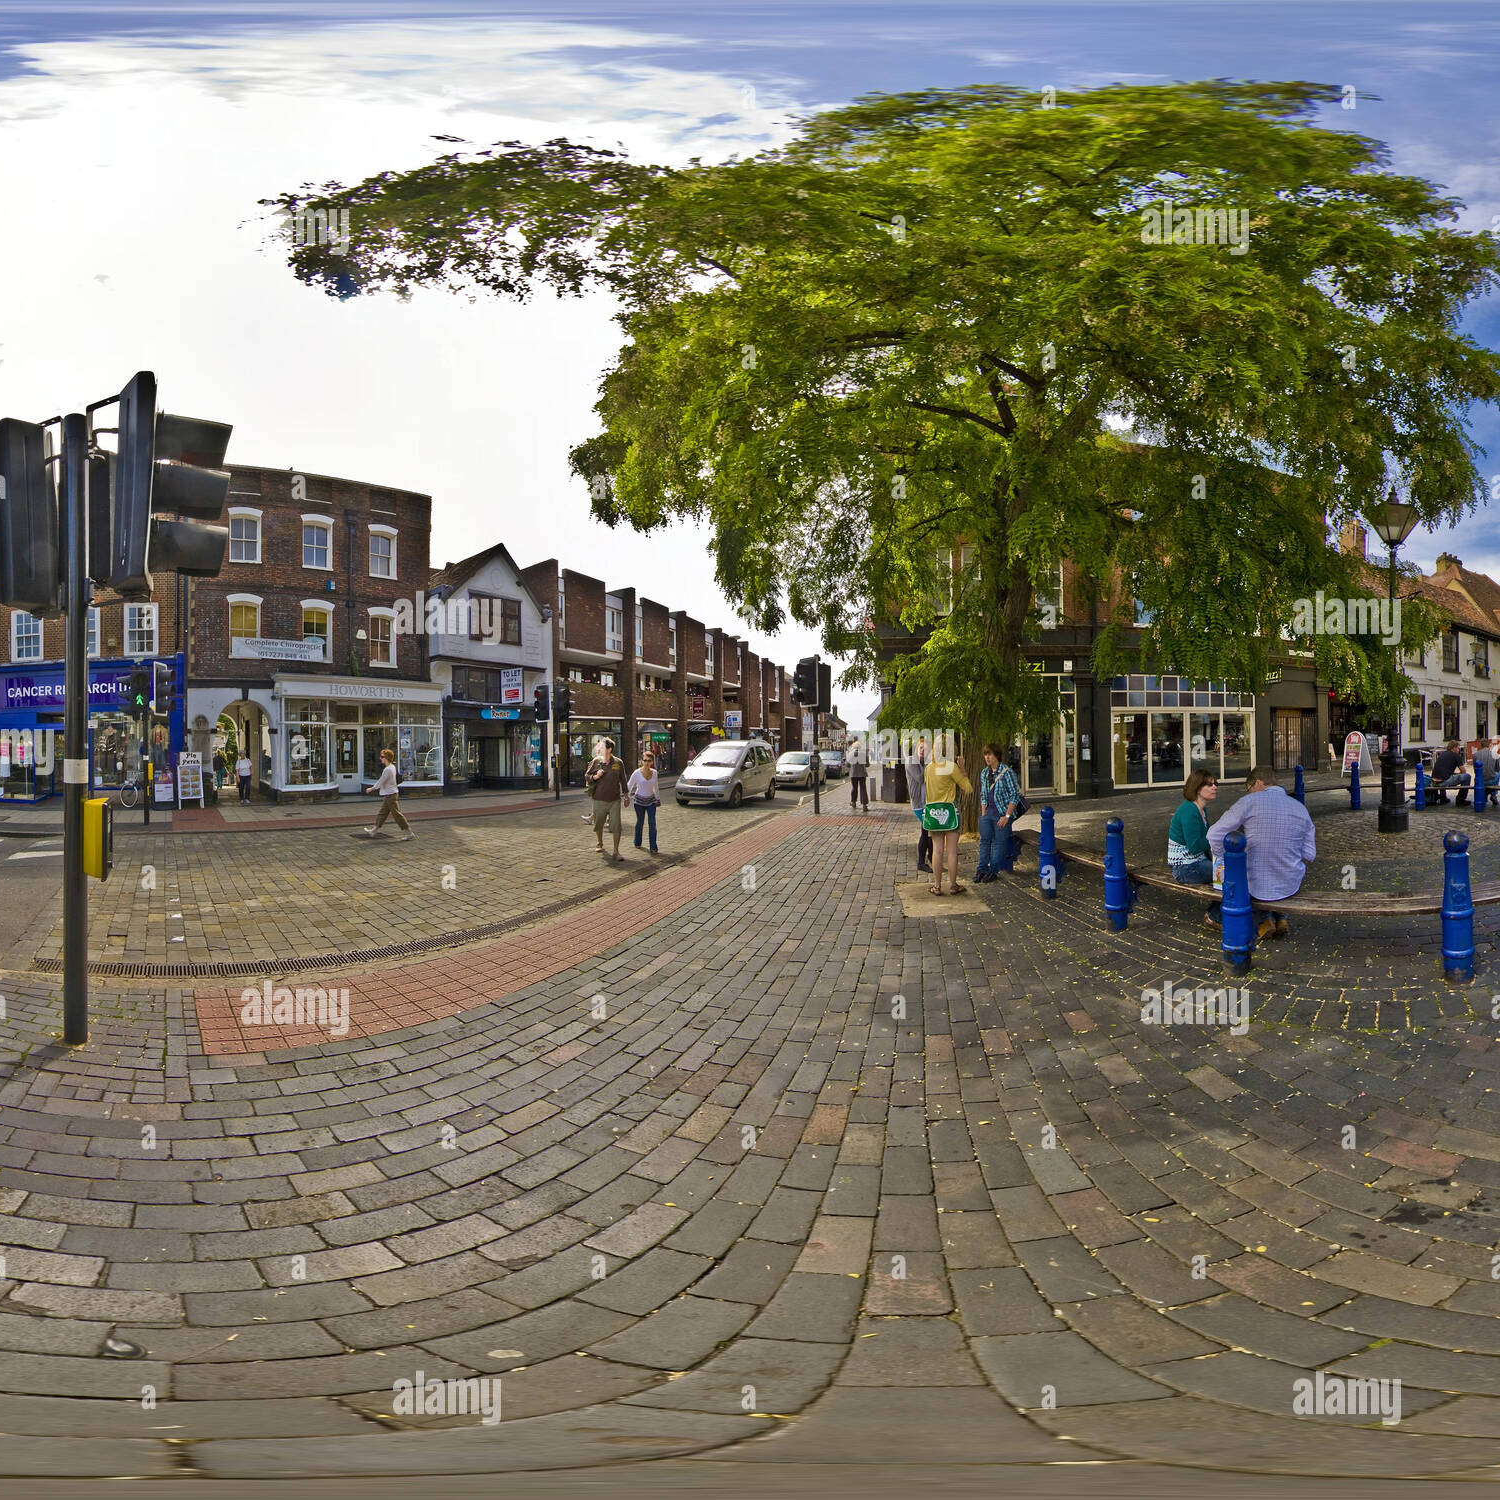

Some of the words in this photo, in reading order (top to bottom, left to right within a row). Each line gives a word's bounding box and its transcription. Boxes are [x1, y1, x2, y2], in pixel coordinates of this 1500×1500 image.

[245, 638, 278, 650] Complete
[280, 640, 322, 650] Chiropractic
[8, 686, 52, 698] CANCER
[55, 684, 116, 696] RARCH
[329, 684, 404, 698] HOWORTH'S
[930, 808, 949, 816] Gola
